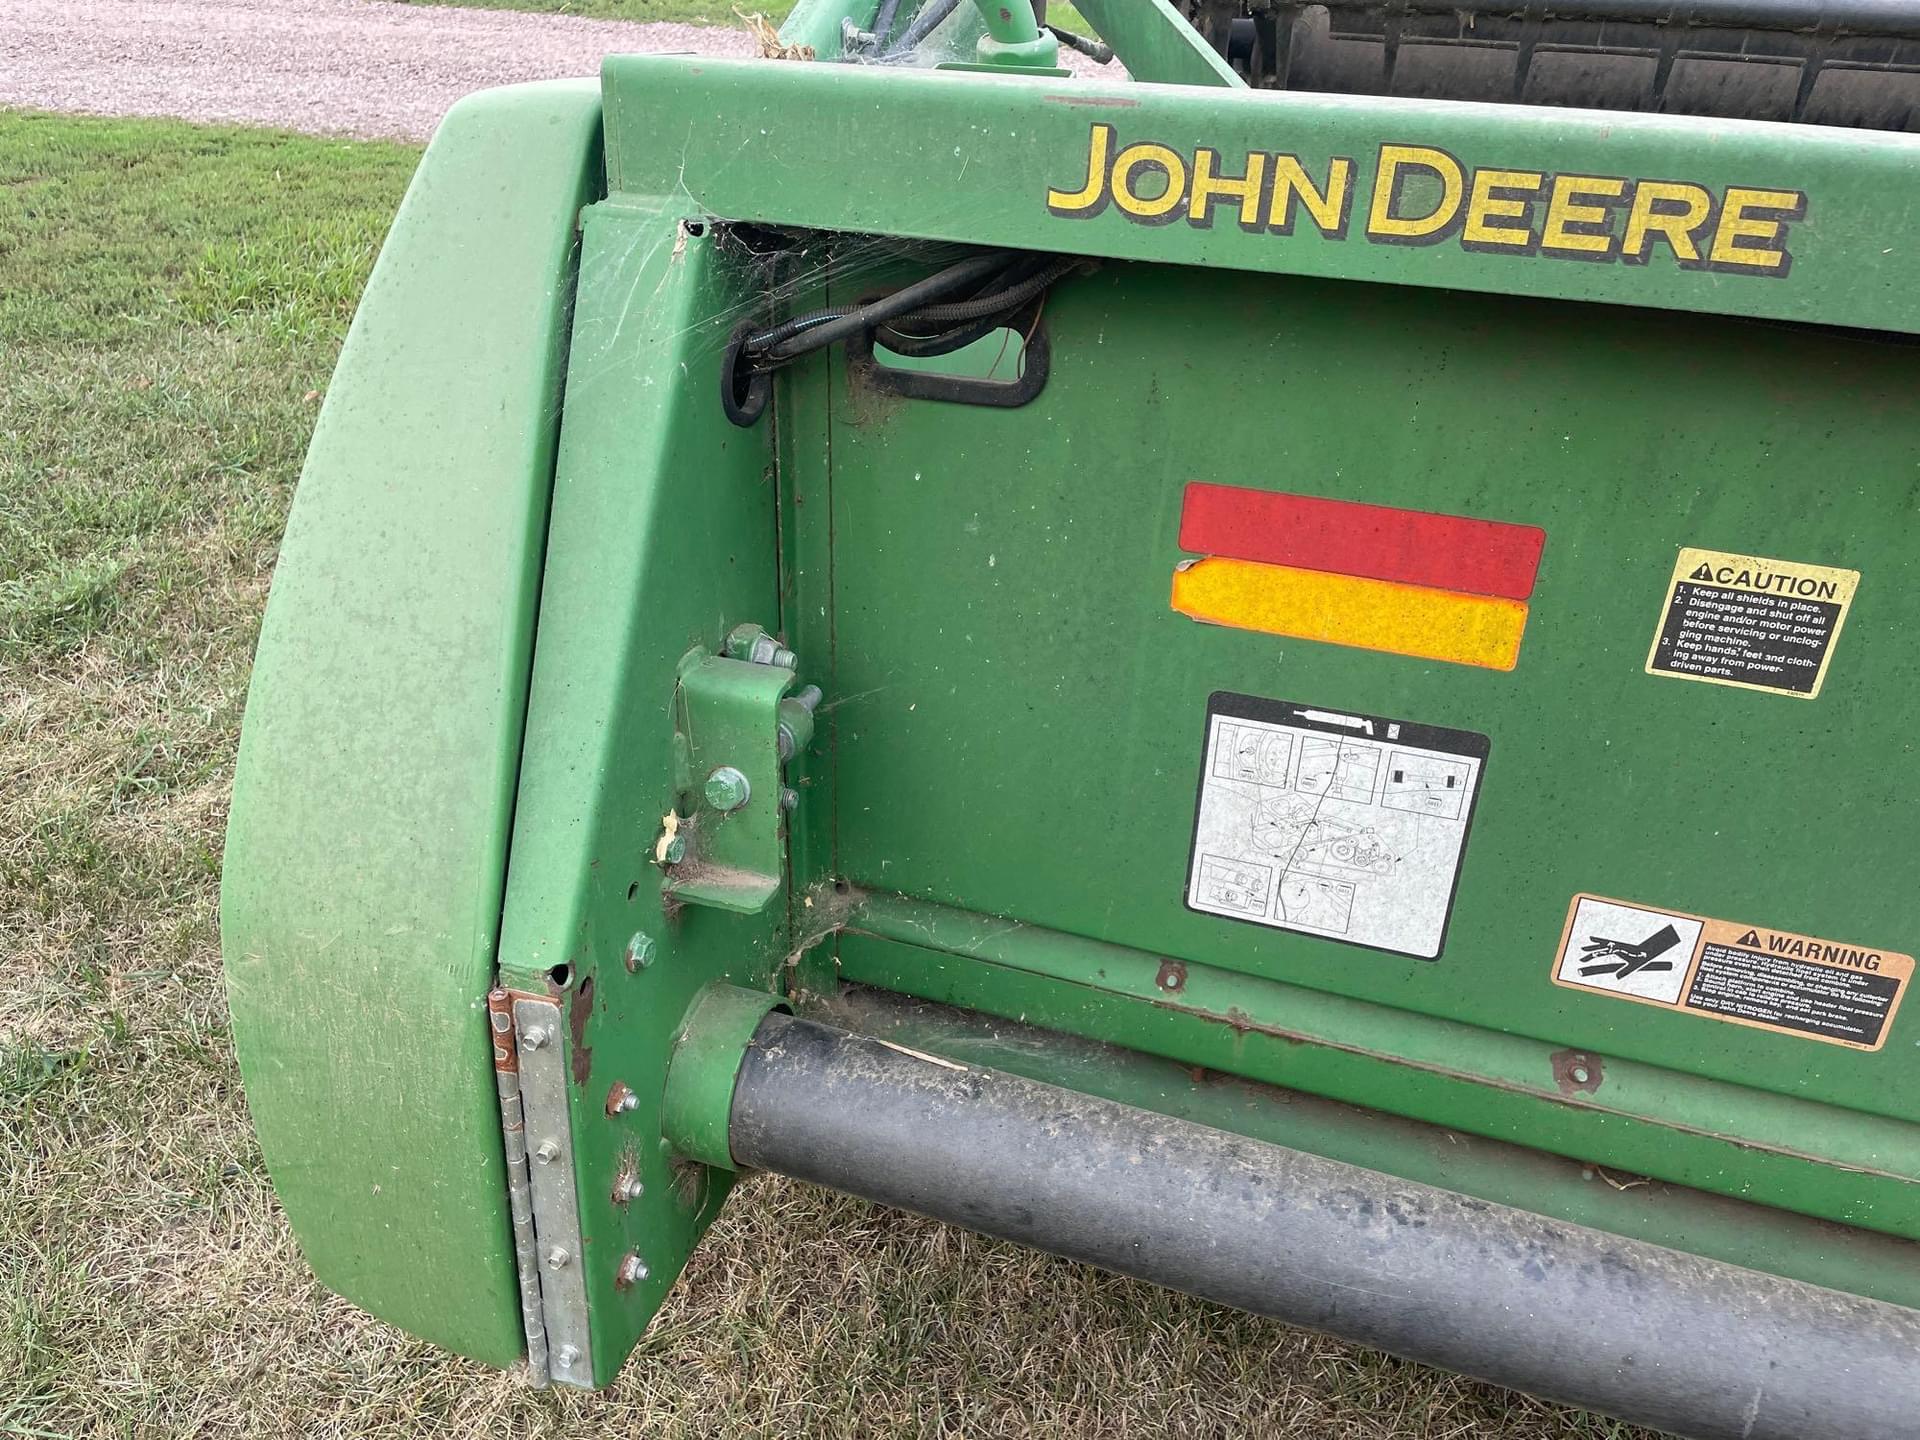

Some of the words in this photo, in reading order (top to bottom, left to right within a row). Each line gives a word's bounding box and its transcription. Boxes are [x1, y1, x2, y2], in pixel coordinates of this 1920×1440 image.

[1715, 567, 1838, 599] CAUTION
[1674, 595, 1683, 604] 2.
[1689, 597, 1744, 614] Disengage
[1746, 607, 1767, 616] and
[1768, 609, 1793, 620] shut
[1795, 613, 1811, 622] off
[1811, 616, 1826, 624] all
[1679, 585, 1686, 594] 1.
[1692, 587, 1719, 599] Keep
[1720, 591, 1735, 600] all
[1736, 594, 1775, 606] shields
[1777, 599, 1788, 608] in
[1789, 602, 1821, 613] place.
[1682, 618, 1716, 631] before
[1717, 625, 1766, 640] servicing
[1768, 632, 1781, 640] or
[1782, 635, 1822, 648] unclog-
[1685, 609, 1720, 620] engine
[1722, 615, 1758, 625] and/or
[1759, 620, 1792, 631] motor
[1792, 625, 1826, 636] power
[1661, 637, 1670, 646] 3.
[1676, 639, 1702, 651] Keep
[1742, 649, 1762, 659] feet
[1764, 654, 1785, 663] and
[1786, 657, 1816, 667] cloth-
[1678, 629, 1702, 641] ging
[1704, 634, 1751, 647] machine.
[1670, 660, 1702, 671] driven
[1703, 666, 1733, 676] parts.
[1672, 649, 1689, 660] ing
[1691, 653, 1718, 664] away
[1720, 656, 1745, 667] from
[1746, 662, 1783, 672] power-
[1768, 934, 1881, 972] WARNING
